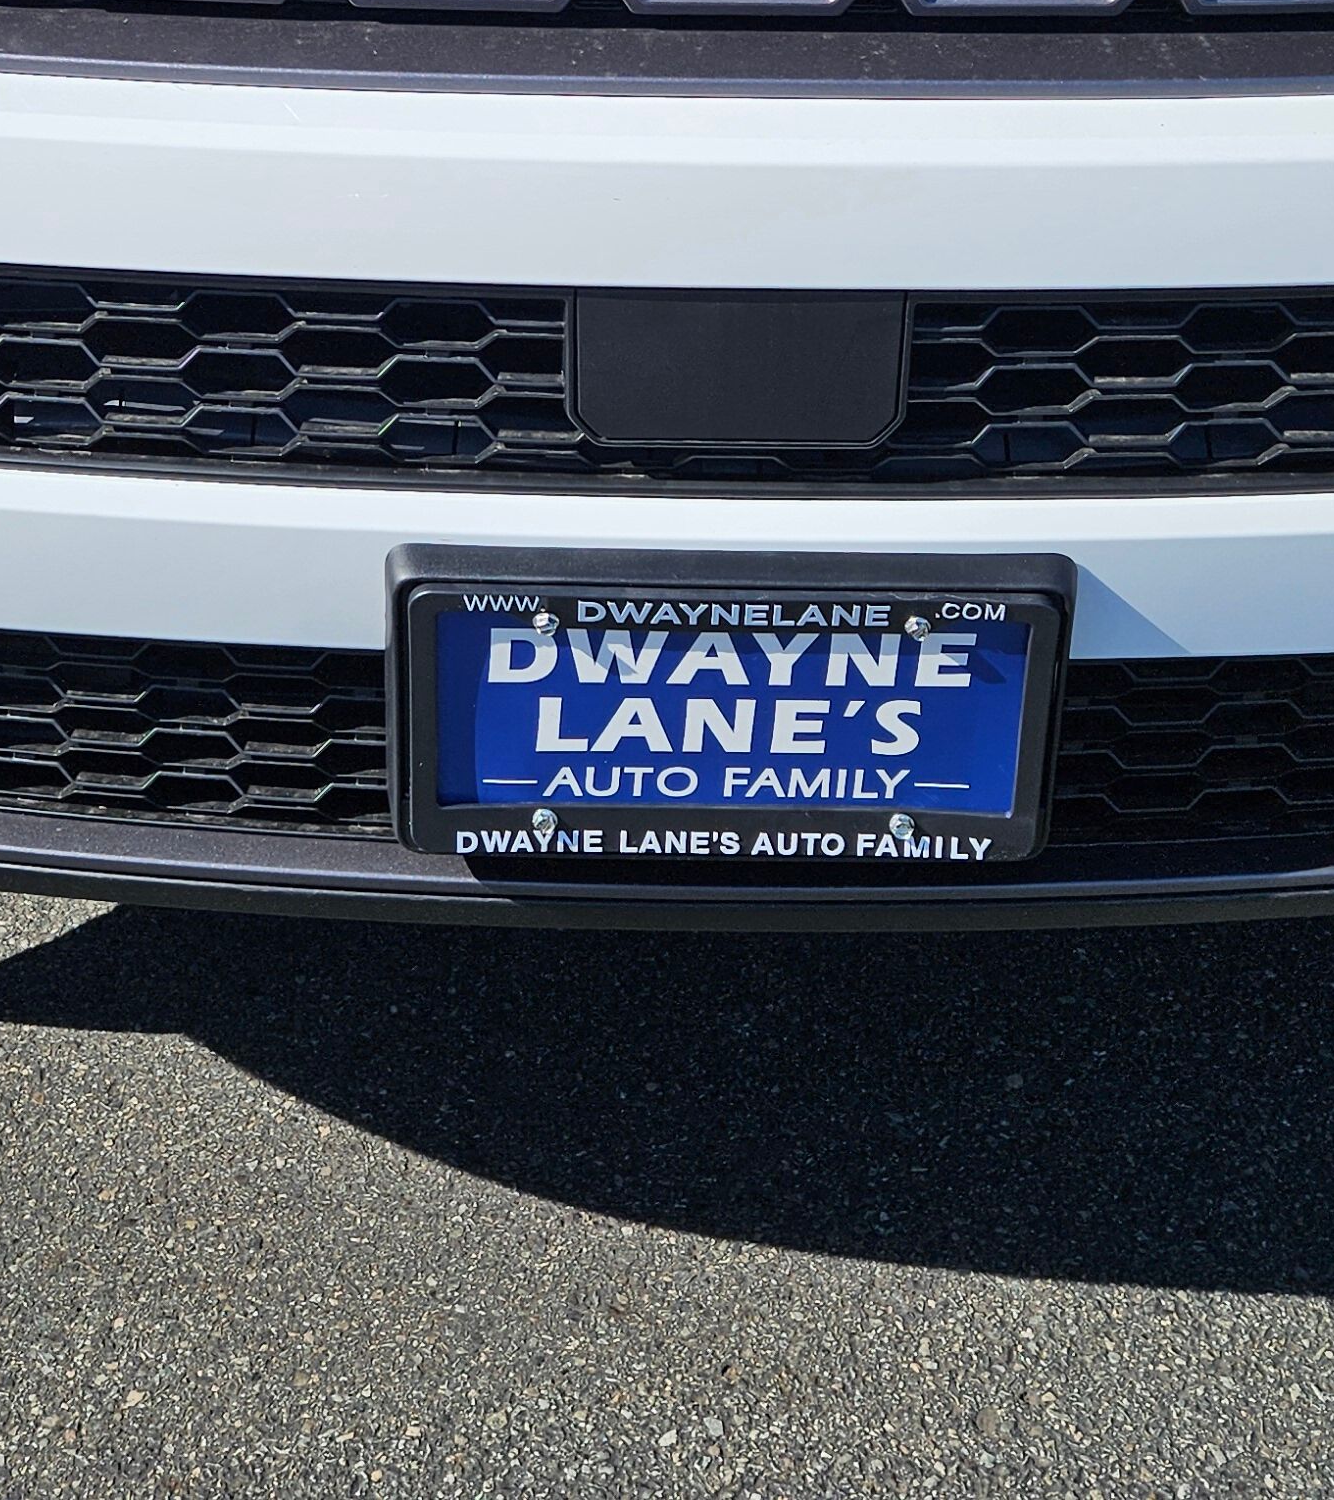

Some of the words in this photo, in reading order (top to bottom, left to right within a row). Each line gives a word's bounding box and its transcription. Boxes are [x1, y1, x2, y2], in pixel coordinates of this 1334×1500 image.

[577, 600, 891, 626] DWAYNELANE
[935, 602, 1006, 621] .COM
[487, 628, 978, 687] DWAYNE
[536, 697, 922, 755] LANE'S
[542, 766, 698, 797] AUTO
[723, 767, 910, 799] FAMILY
[456, 830, 603, 854] DWAYNE
[619, 831, 741, 855] LANE'S
[751, 832, 845, 856] AUTO
[856, 833, 992, 860] FAMILY
